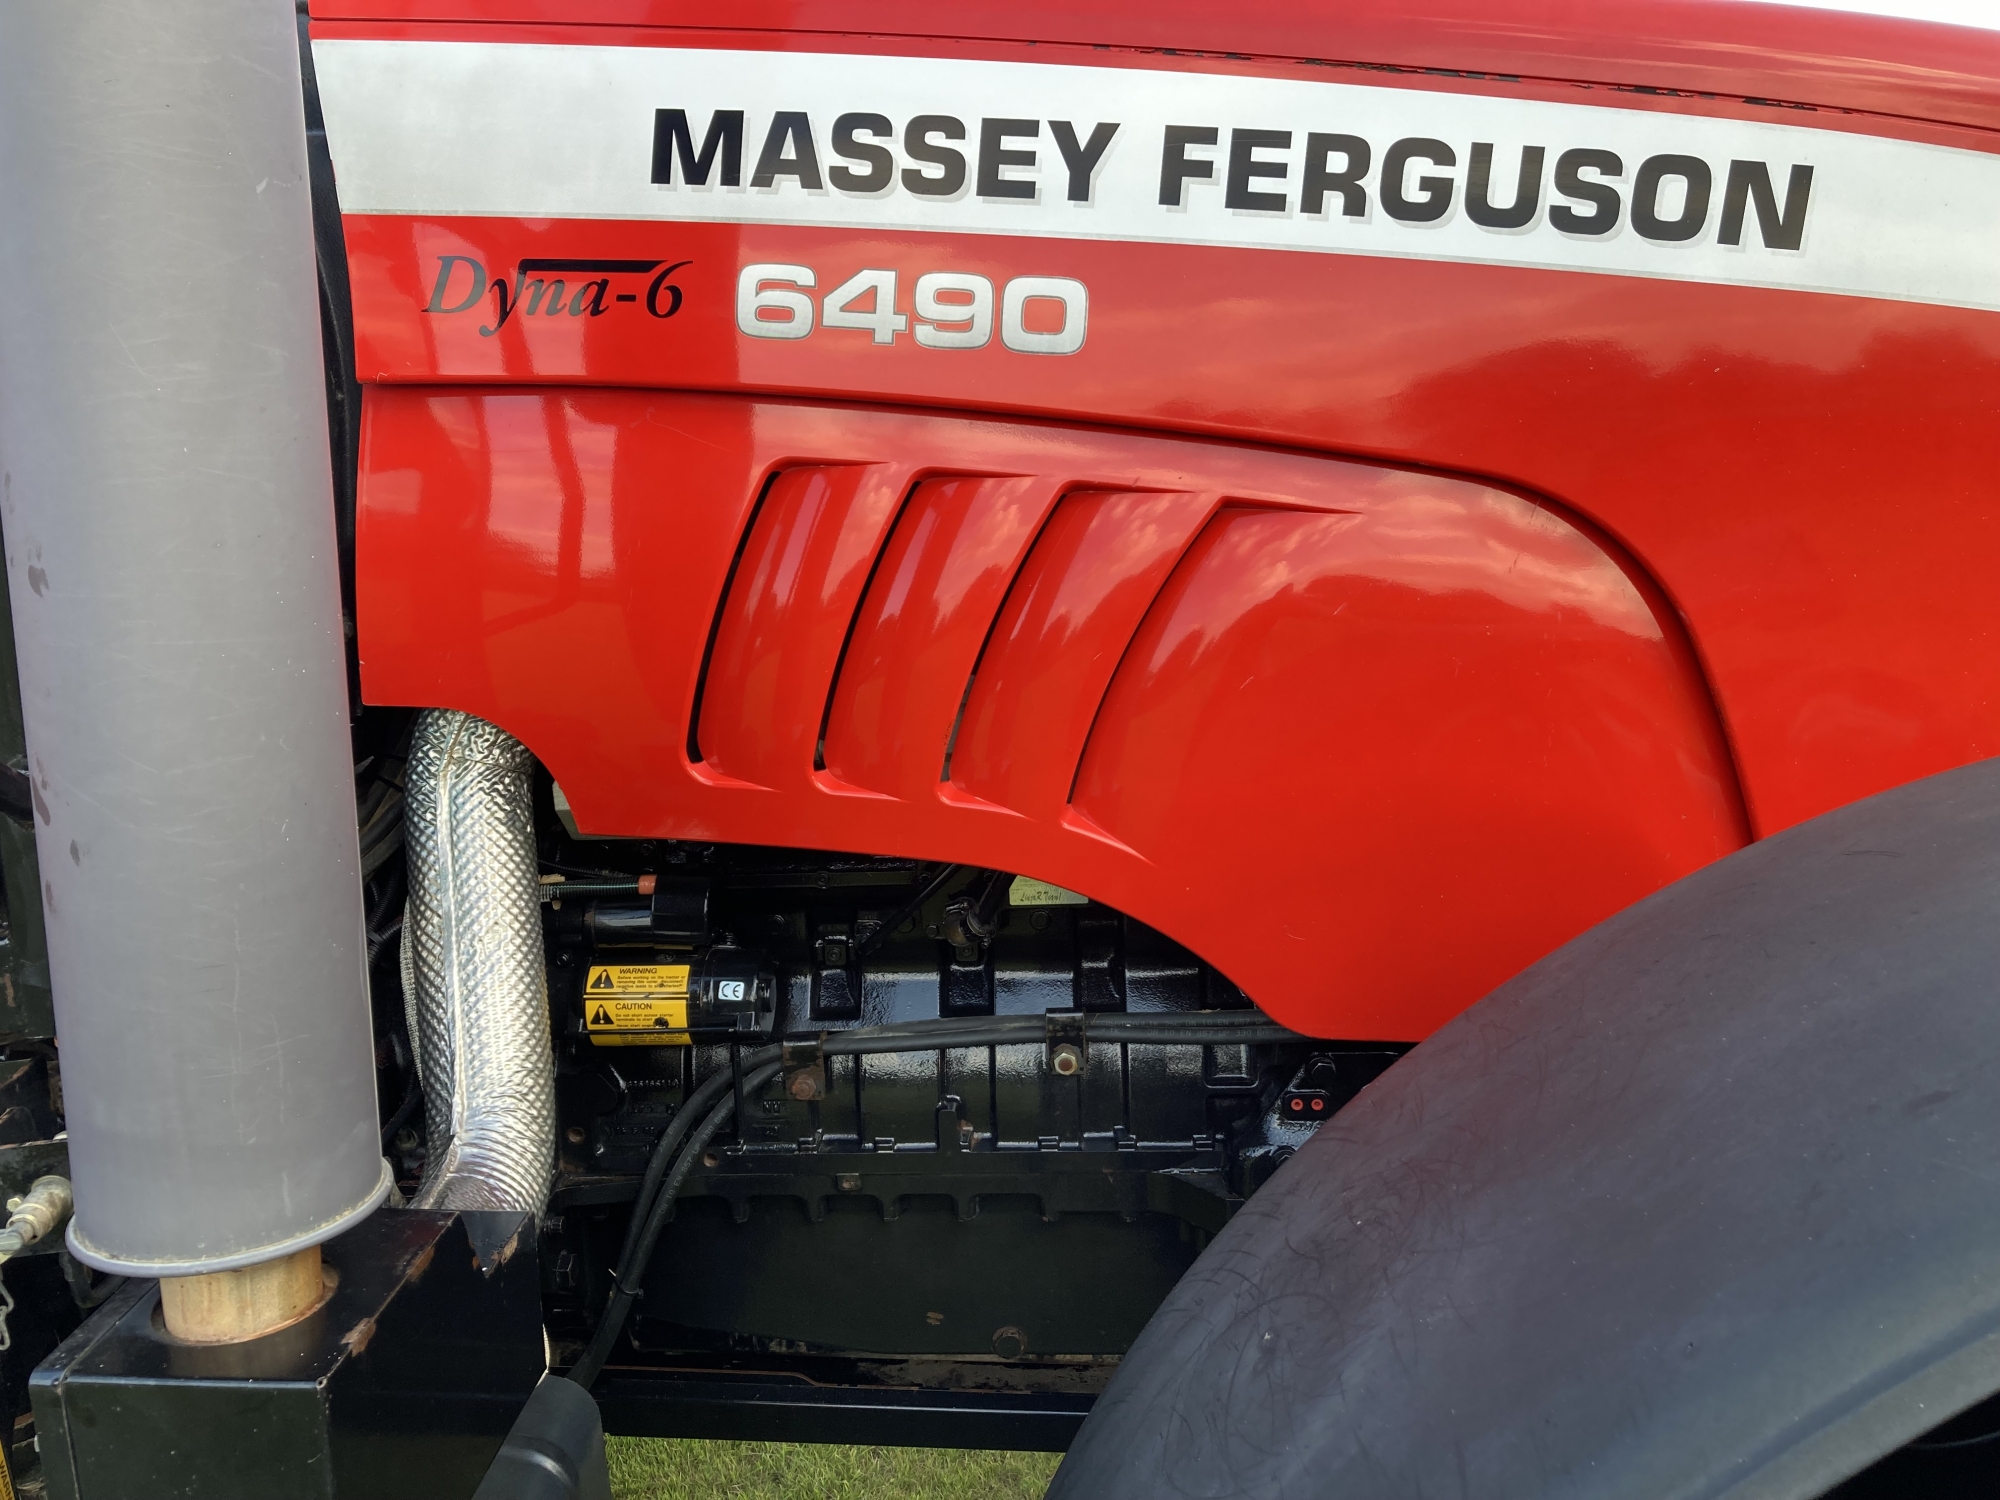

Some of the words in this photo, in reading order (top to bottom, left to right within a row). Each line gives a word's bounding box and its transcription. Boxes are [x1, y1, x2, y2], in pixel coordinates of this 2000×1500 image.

[651, 109, 1120, 201] MASSEY
[1159, 126, 1814, 250] FERGUSON
[421, 255, 694, 337] Dyna-6
[735, 263, 1088, 355] 6490
[615, 1002, 653, 1010] CAUTION
[721, 983, 742, 999] CE
[1235, 1029, 1252, 1037] 330
[673, 1175, 684, 1187] EN
[700, 1125, 715, 1141] 330
